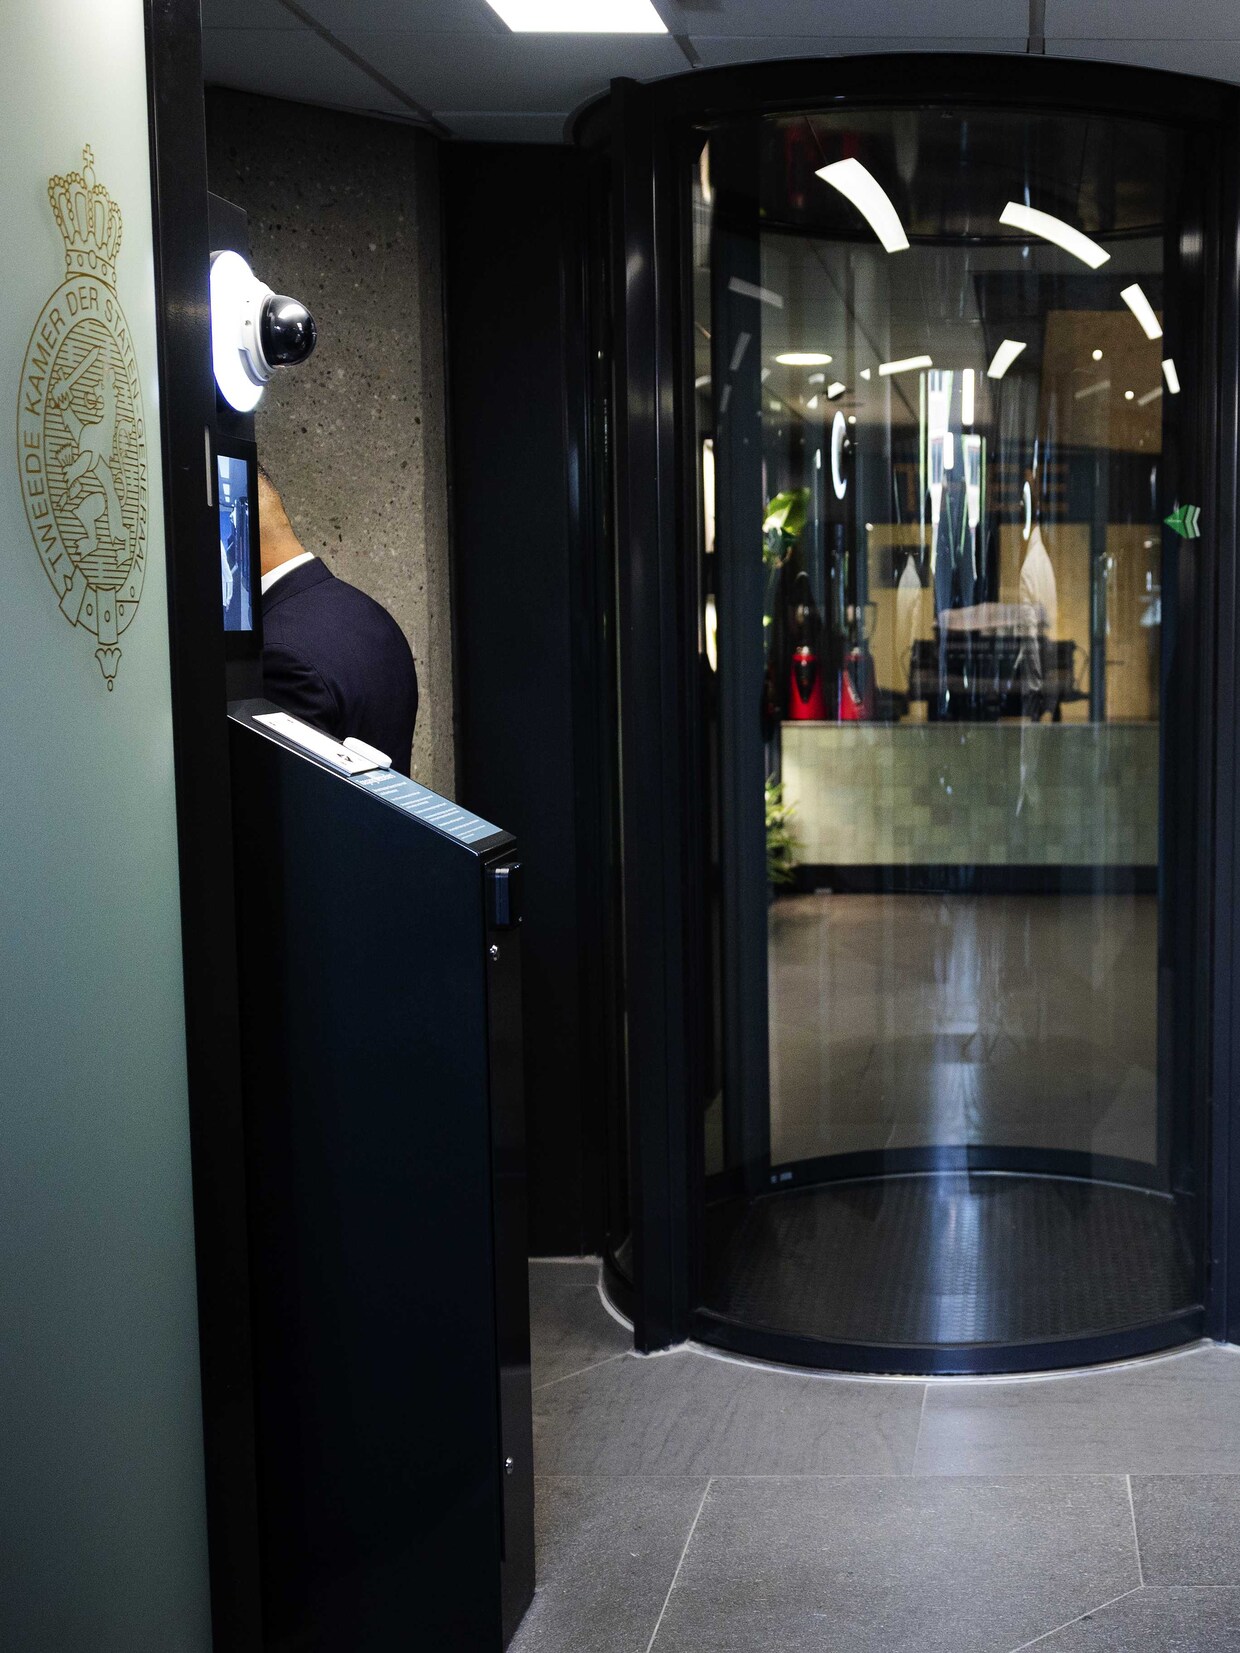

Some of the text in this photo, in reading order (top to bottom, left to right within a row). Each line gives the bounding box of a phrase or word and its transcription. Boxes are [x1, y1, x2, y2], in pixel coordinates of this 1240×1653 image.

[66, 286, 99, 317] DER
[25, 308, 65, 416] KAMER
[24, 430, 63, 574] TWEEDE
